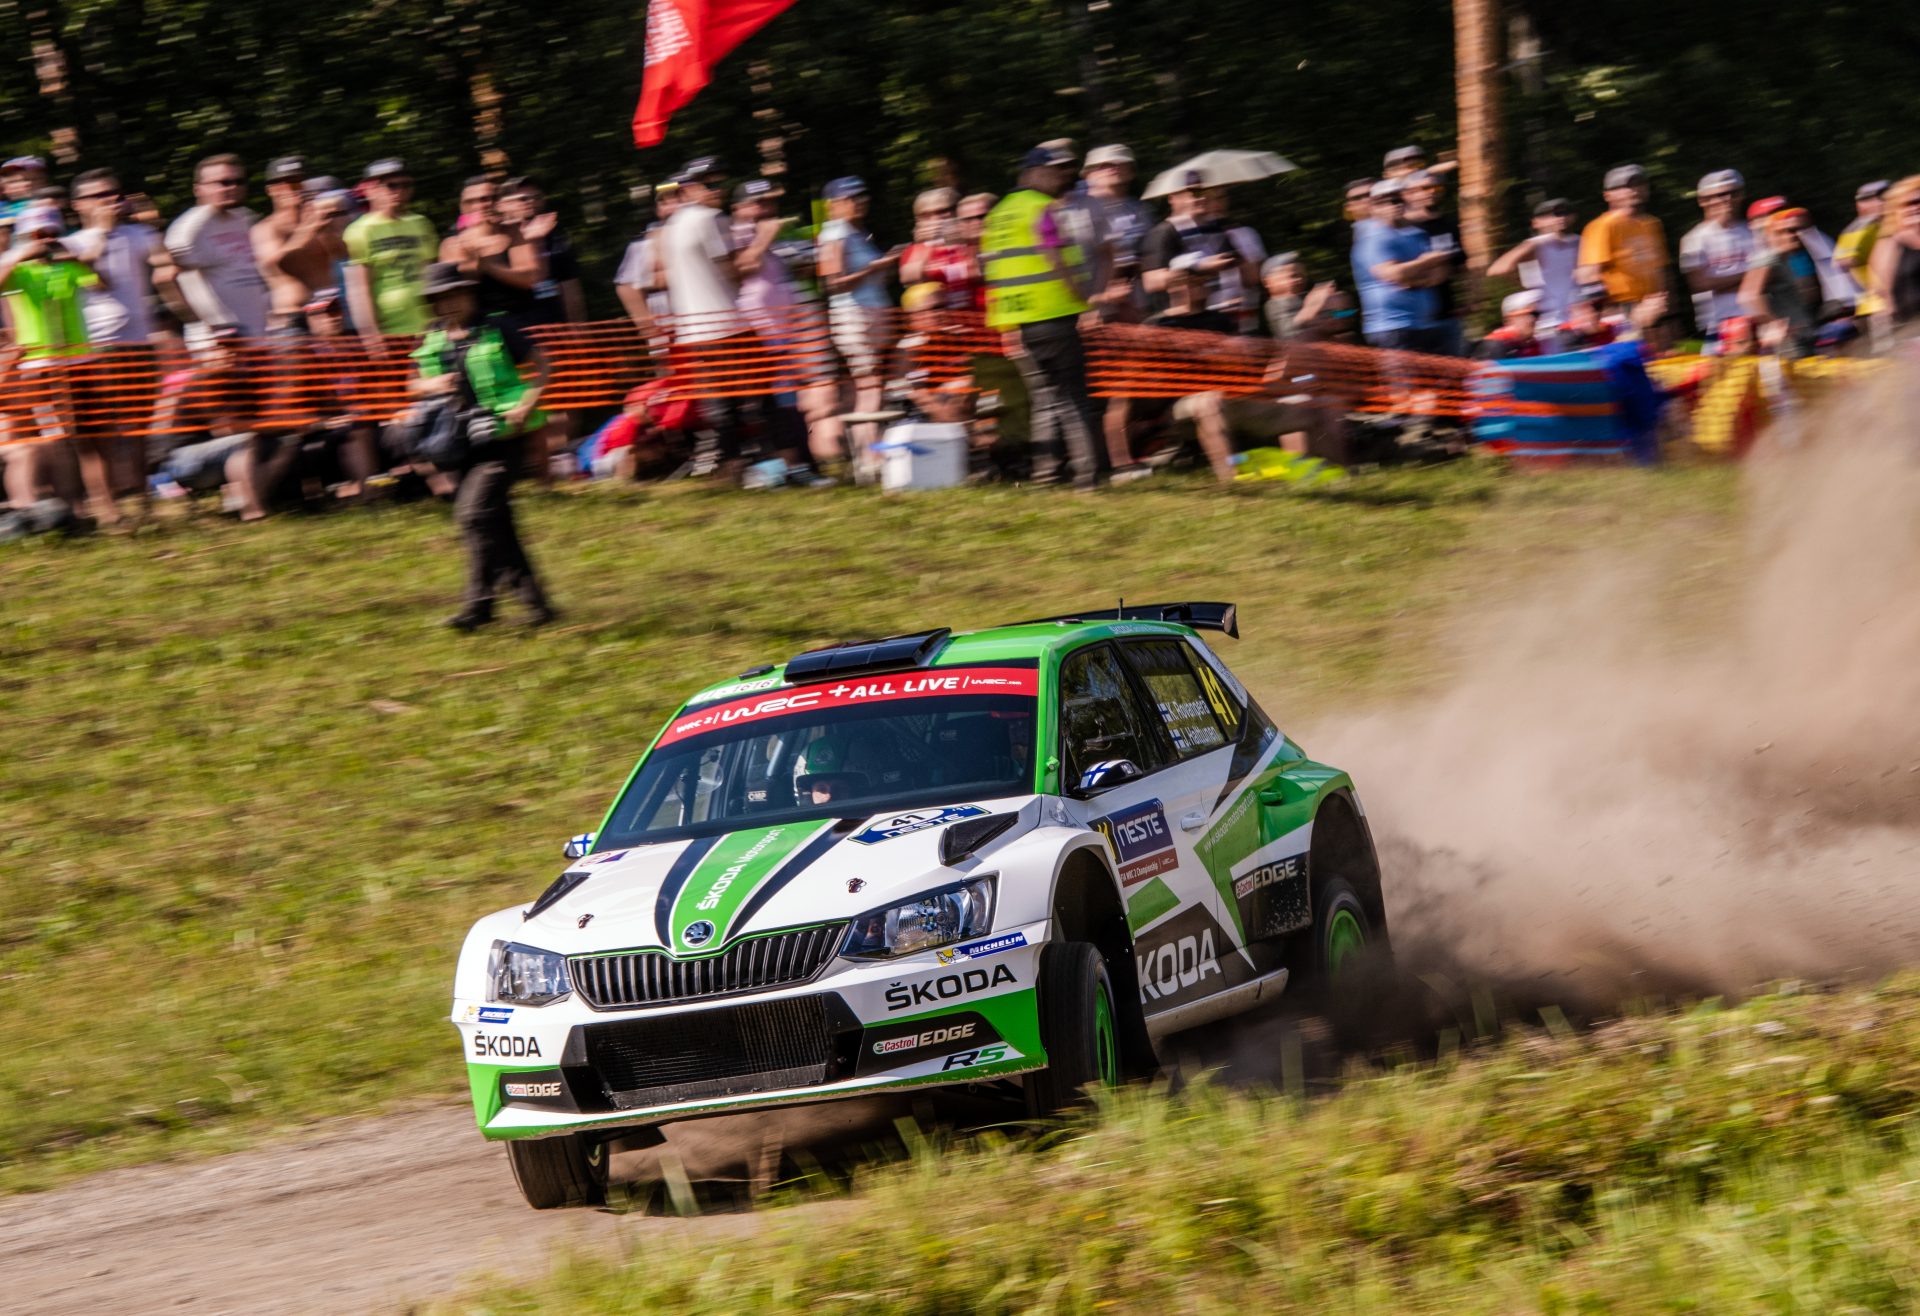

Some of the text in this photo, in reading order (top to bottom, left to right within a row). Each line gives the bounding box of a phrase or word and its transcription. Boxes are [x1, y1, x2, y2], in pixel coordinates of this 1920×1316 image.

[721, 691, 822, 722] WRC
[904, 677, 960, 693] LIVE
[1198, 667, 1238, 725] 41
[676, 717, 713, 733] WRC 2
[882, 813, 964, 838] NESTE
[892, 814, 925, 827] 41
[1117, 812, 1163, 847] NESTE
[695, 862, 747, 910] ŠKODA
[1254, 857, 1300, 890] EDGE
[969, 935, 1024, 955] MICHELIN
[1136, 927, 1221, 1005] KODA
[885, 963, 1017, 1011] ŠKODA
[474, 1030, 542, 1058] ŠKODA
[884, 1022, 977, 1052] Castrol EDGE
[941, 1045, 1009, 1071] R5
[527, 1082, 562, 1097] EDGE
